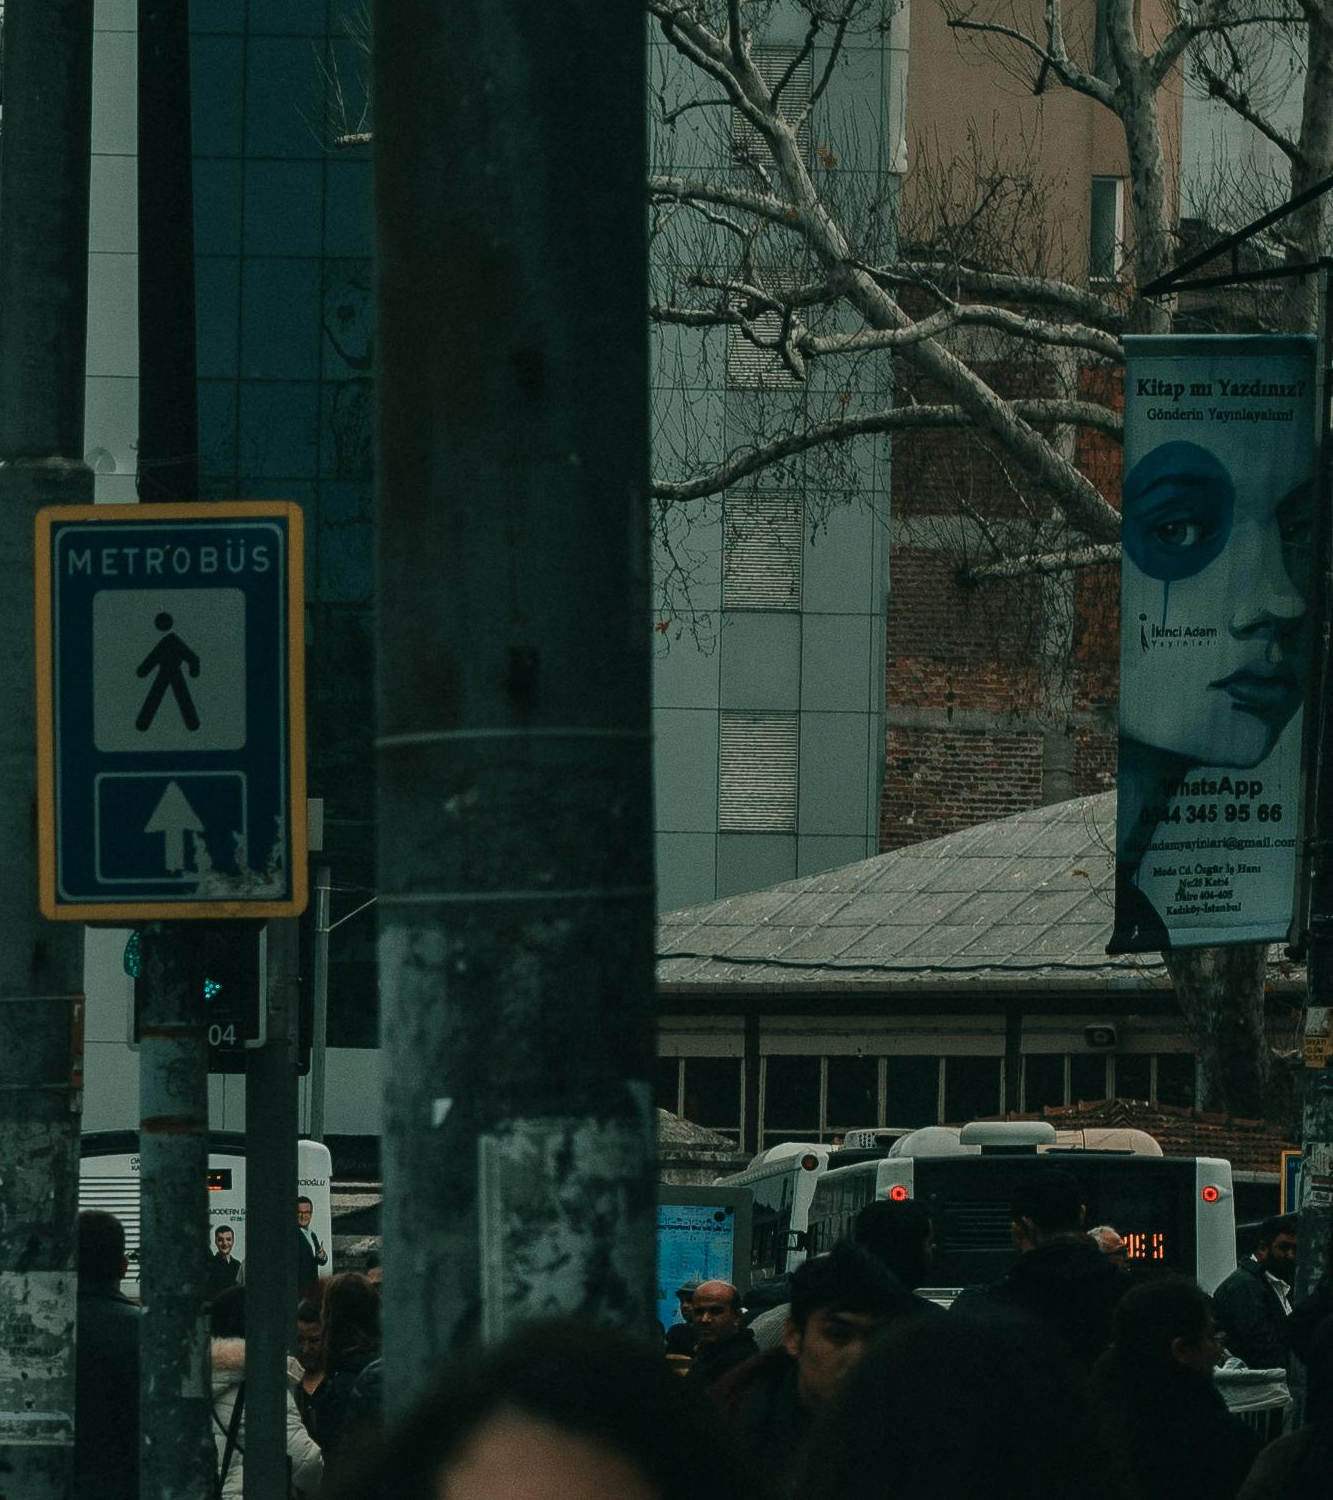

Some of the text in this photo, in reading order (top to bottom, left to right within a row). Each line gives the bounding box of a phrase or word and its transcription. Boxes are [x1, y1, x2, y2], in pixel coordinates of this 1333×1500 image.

[1136, 378, 1306, 402] Kitap mı Yazdınız?
[1146, 408, 1204, 421] Gönderin
[67, 538, 270, 576] METROBÜS
[1151, 623, 1218, 638] İkinci Adam
[1164, 776, 1263, 799] WhatsApp
[1186, 804, 1218, 824] 345
[1224, 803, 1250, 823] 95
[1257, 803, 1283, 822] 66
[208, 1023, 237, 1046] 04
